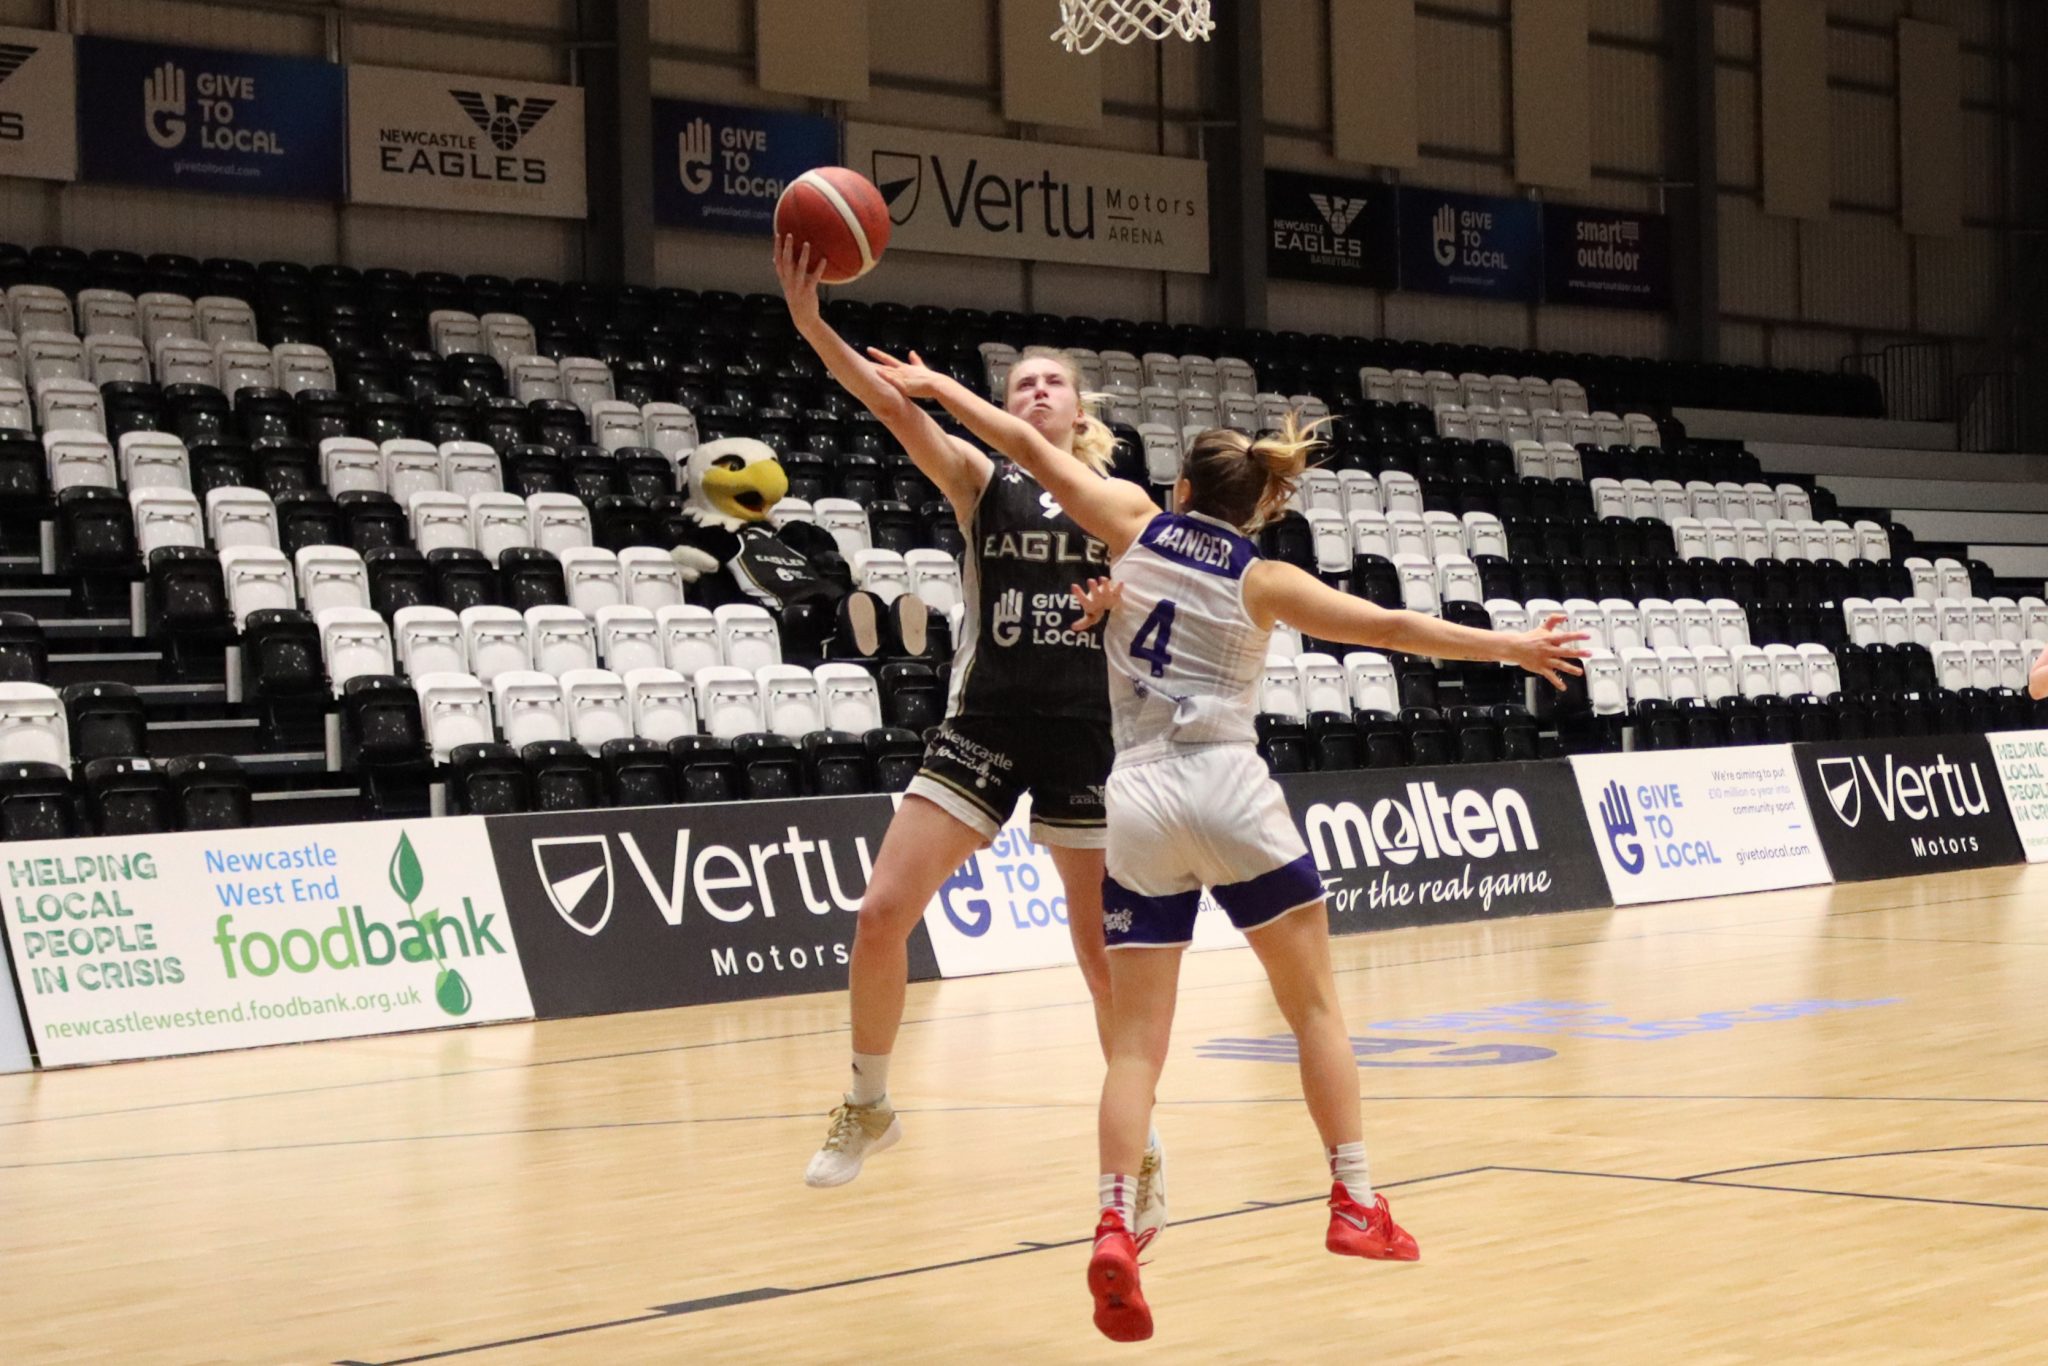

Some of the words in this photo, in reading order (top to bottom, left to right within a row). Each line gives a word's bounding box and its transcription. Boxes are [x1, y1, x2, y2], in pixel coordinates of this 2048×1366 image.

[196, 73, 255, 100] GIVE
[198, 100, 234, 124] TO
[200, 126, 284, 155] LOCAL
[380, 130, 476, 149] NEWCASTLE
[720, 127, 766, 152] GIVE
[174, 160, 261, 177] givetolocal.com
[380, 146, 546, 184] EAGLES
[721, 151, 750, 173] TO
[930, 155, 1095, 240] Vertu
[1106, 187, 1195, 216] Motors
[1108, 225, 1164, 245] ARENA
[1273, 218, 1324, 234] NEWCASTLE
[1460, 210, 1492, 231] GIVE
[1576, 220, 1622, 244] smart
[1273, 231, 1361, 258] EAGLES
[1461, 230, 1481, 248] TO
[1463, 249, 1508, 270] LOCAL
[1577, 243, 1640, 272] outdoor
[984, 531, 1111, 565] EAGLE
[1032, 593, 1081, 611] GIVE
[1032, 610, 1062, 627] TO
[1032, 629, 1101, 650] LOCAL
[1130, 599, 1176, 678] 4
[940, 728, 1014, 771] Newcastle
[1736, 769, 1762, 782] aiming
[1763, 769, 1772, 778] to
[1772, 768, 1786, 780] put
[2002, 762, 2044, 781] LOCAL
[1637, 784, 1683, 810] GIVE
[1857, 753, 1990, 822] Vertu
[2008, 782, 2048, 801] PEOPL
[1305, 781, 1539, 872] molten
[1644, 814, 1673, 839] TO
[991, 827, 1050, 858] GIV
[1655, 840, 1722, 869] LOCAL
[1736, 844, 1810, 866] givetolocal.com
[1911, 836, 1979, 858] Motors
[8, 852, 158, 887] HELPING
[205, 842, 338, 874] Newcastle
[618, 826, 874, 926] Vertu
[996, 863, 1040, 893] TO
[1368, 870, 1414, 910] the
[1420, 863, 1474, 904] real
[1479, 870, 1551, 911] game
[216, 881, 285, 907] West
[291, 875, 340, 902] End
[15, 890, 134, 923] LOCAL
[1008, 896, 1069, 929] LOC
[23, 923, 158, 959] PEOPLE
[213, 896, 508, 979] foodbank
[711, 942, 850, 977] Motors
[31, 966, 69, 995] IN
[76, 956, 185, 991] CRISIS
[44, 984, 422, 1039] newcastlewestend.foodbank.org.uk
